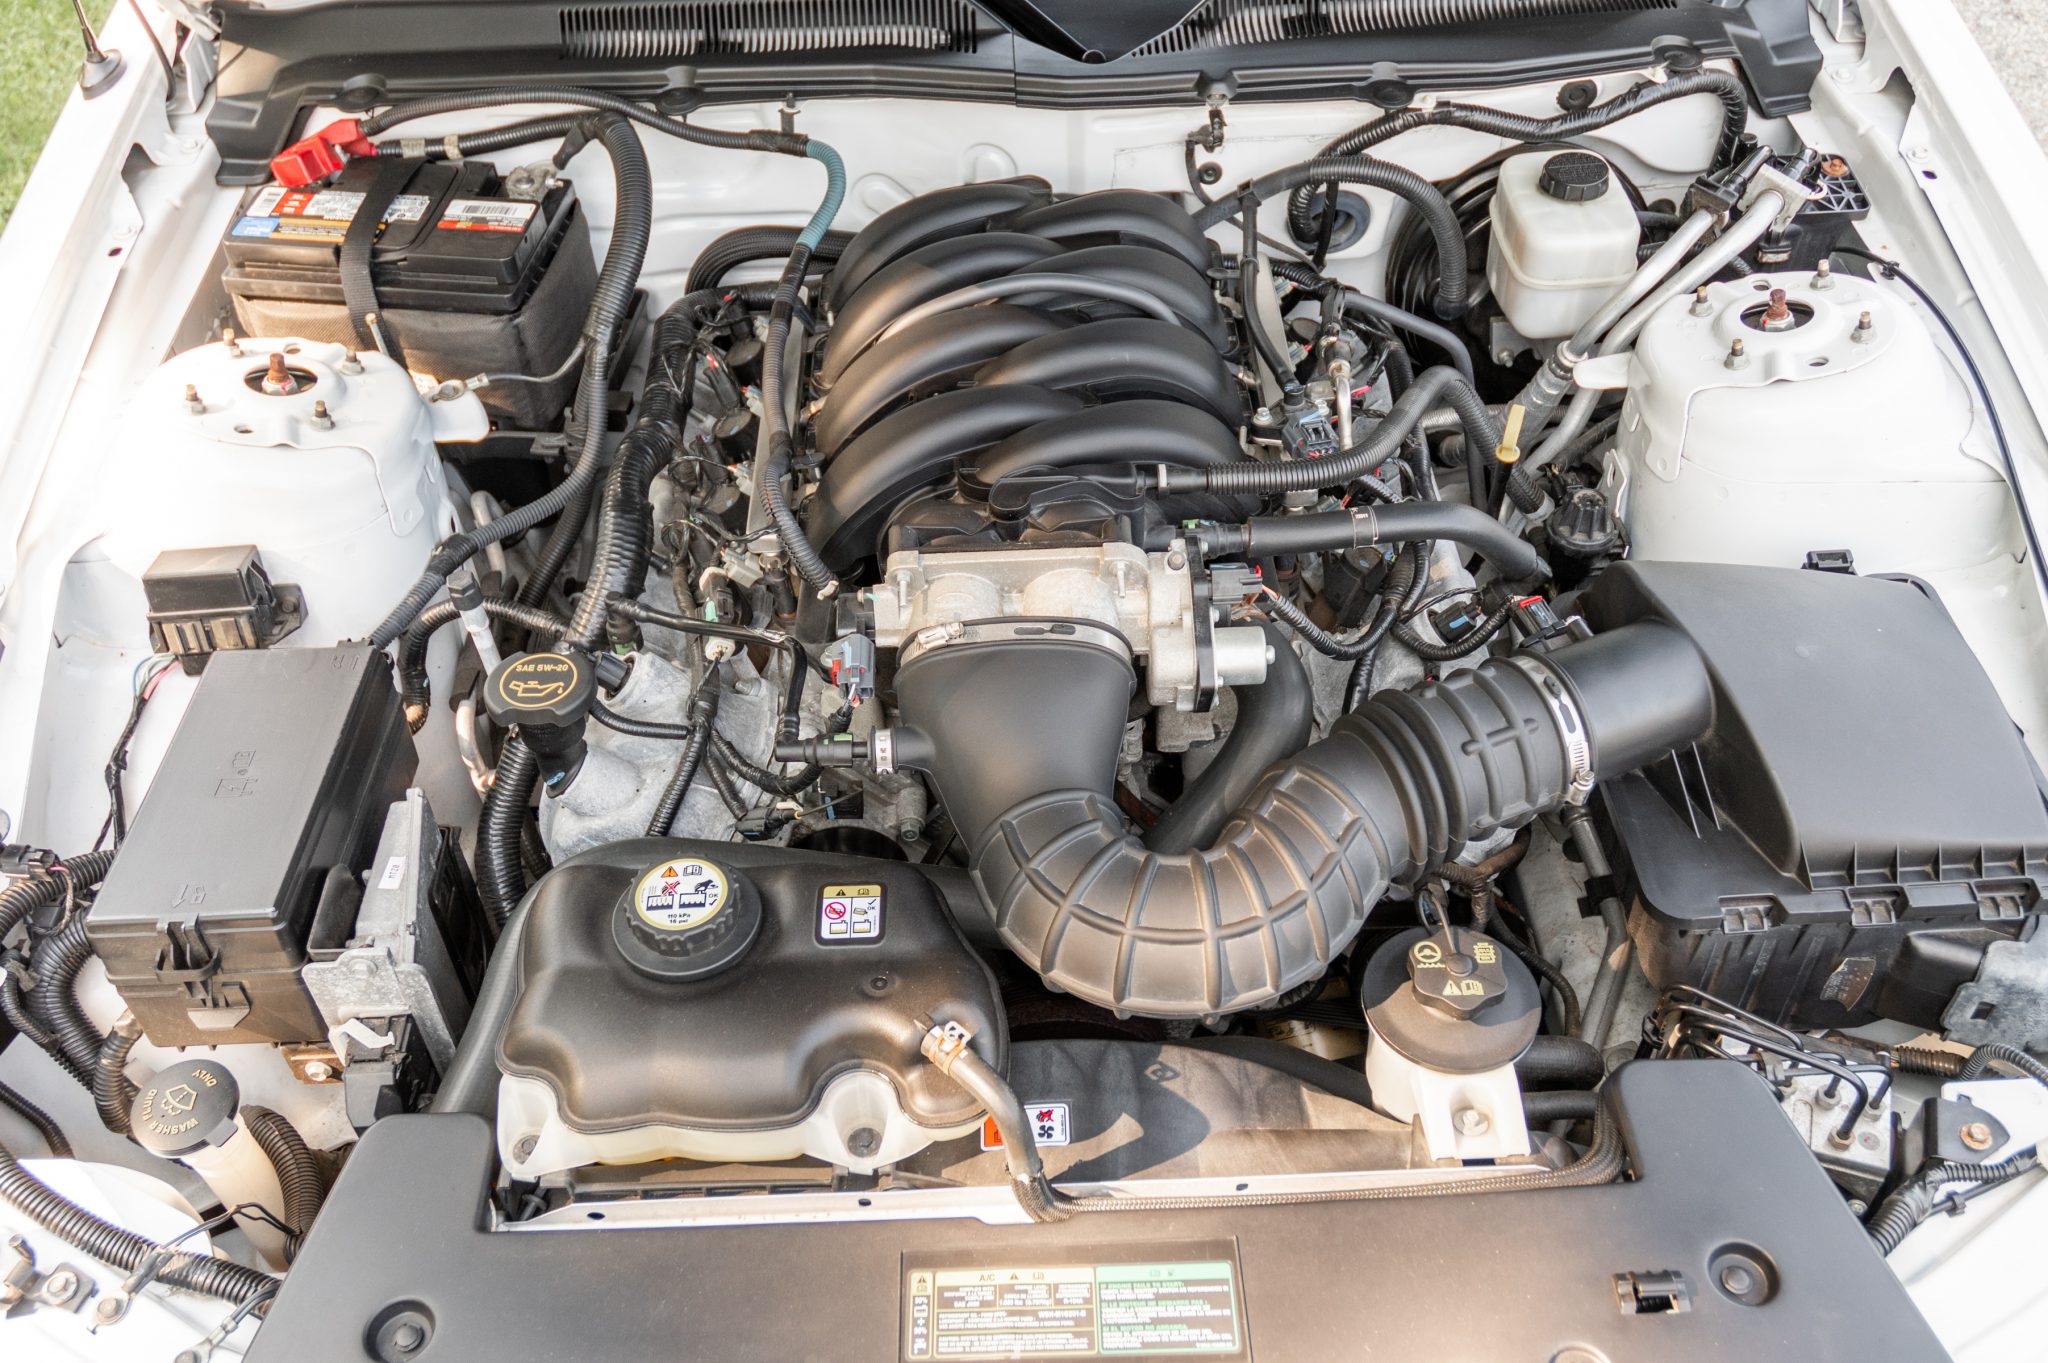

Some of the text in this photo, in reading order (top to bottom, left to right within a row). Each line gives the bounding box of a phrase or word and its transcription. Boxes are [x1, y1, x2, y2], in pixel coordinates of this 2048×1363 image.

[516, 664, 569, 672] SAE 5W-20
[192, 1069, 218, 1087] ONLY
[142, 1088, 158, 1121] FLUID
[149, 1118, 199, 1135] WASHER
[979, 1273, 996, 1282] A/C
